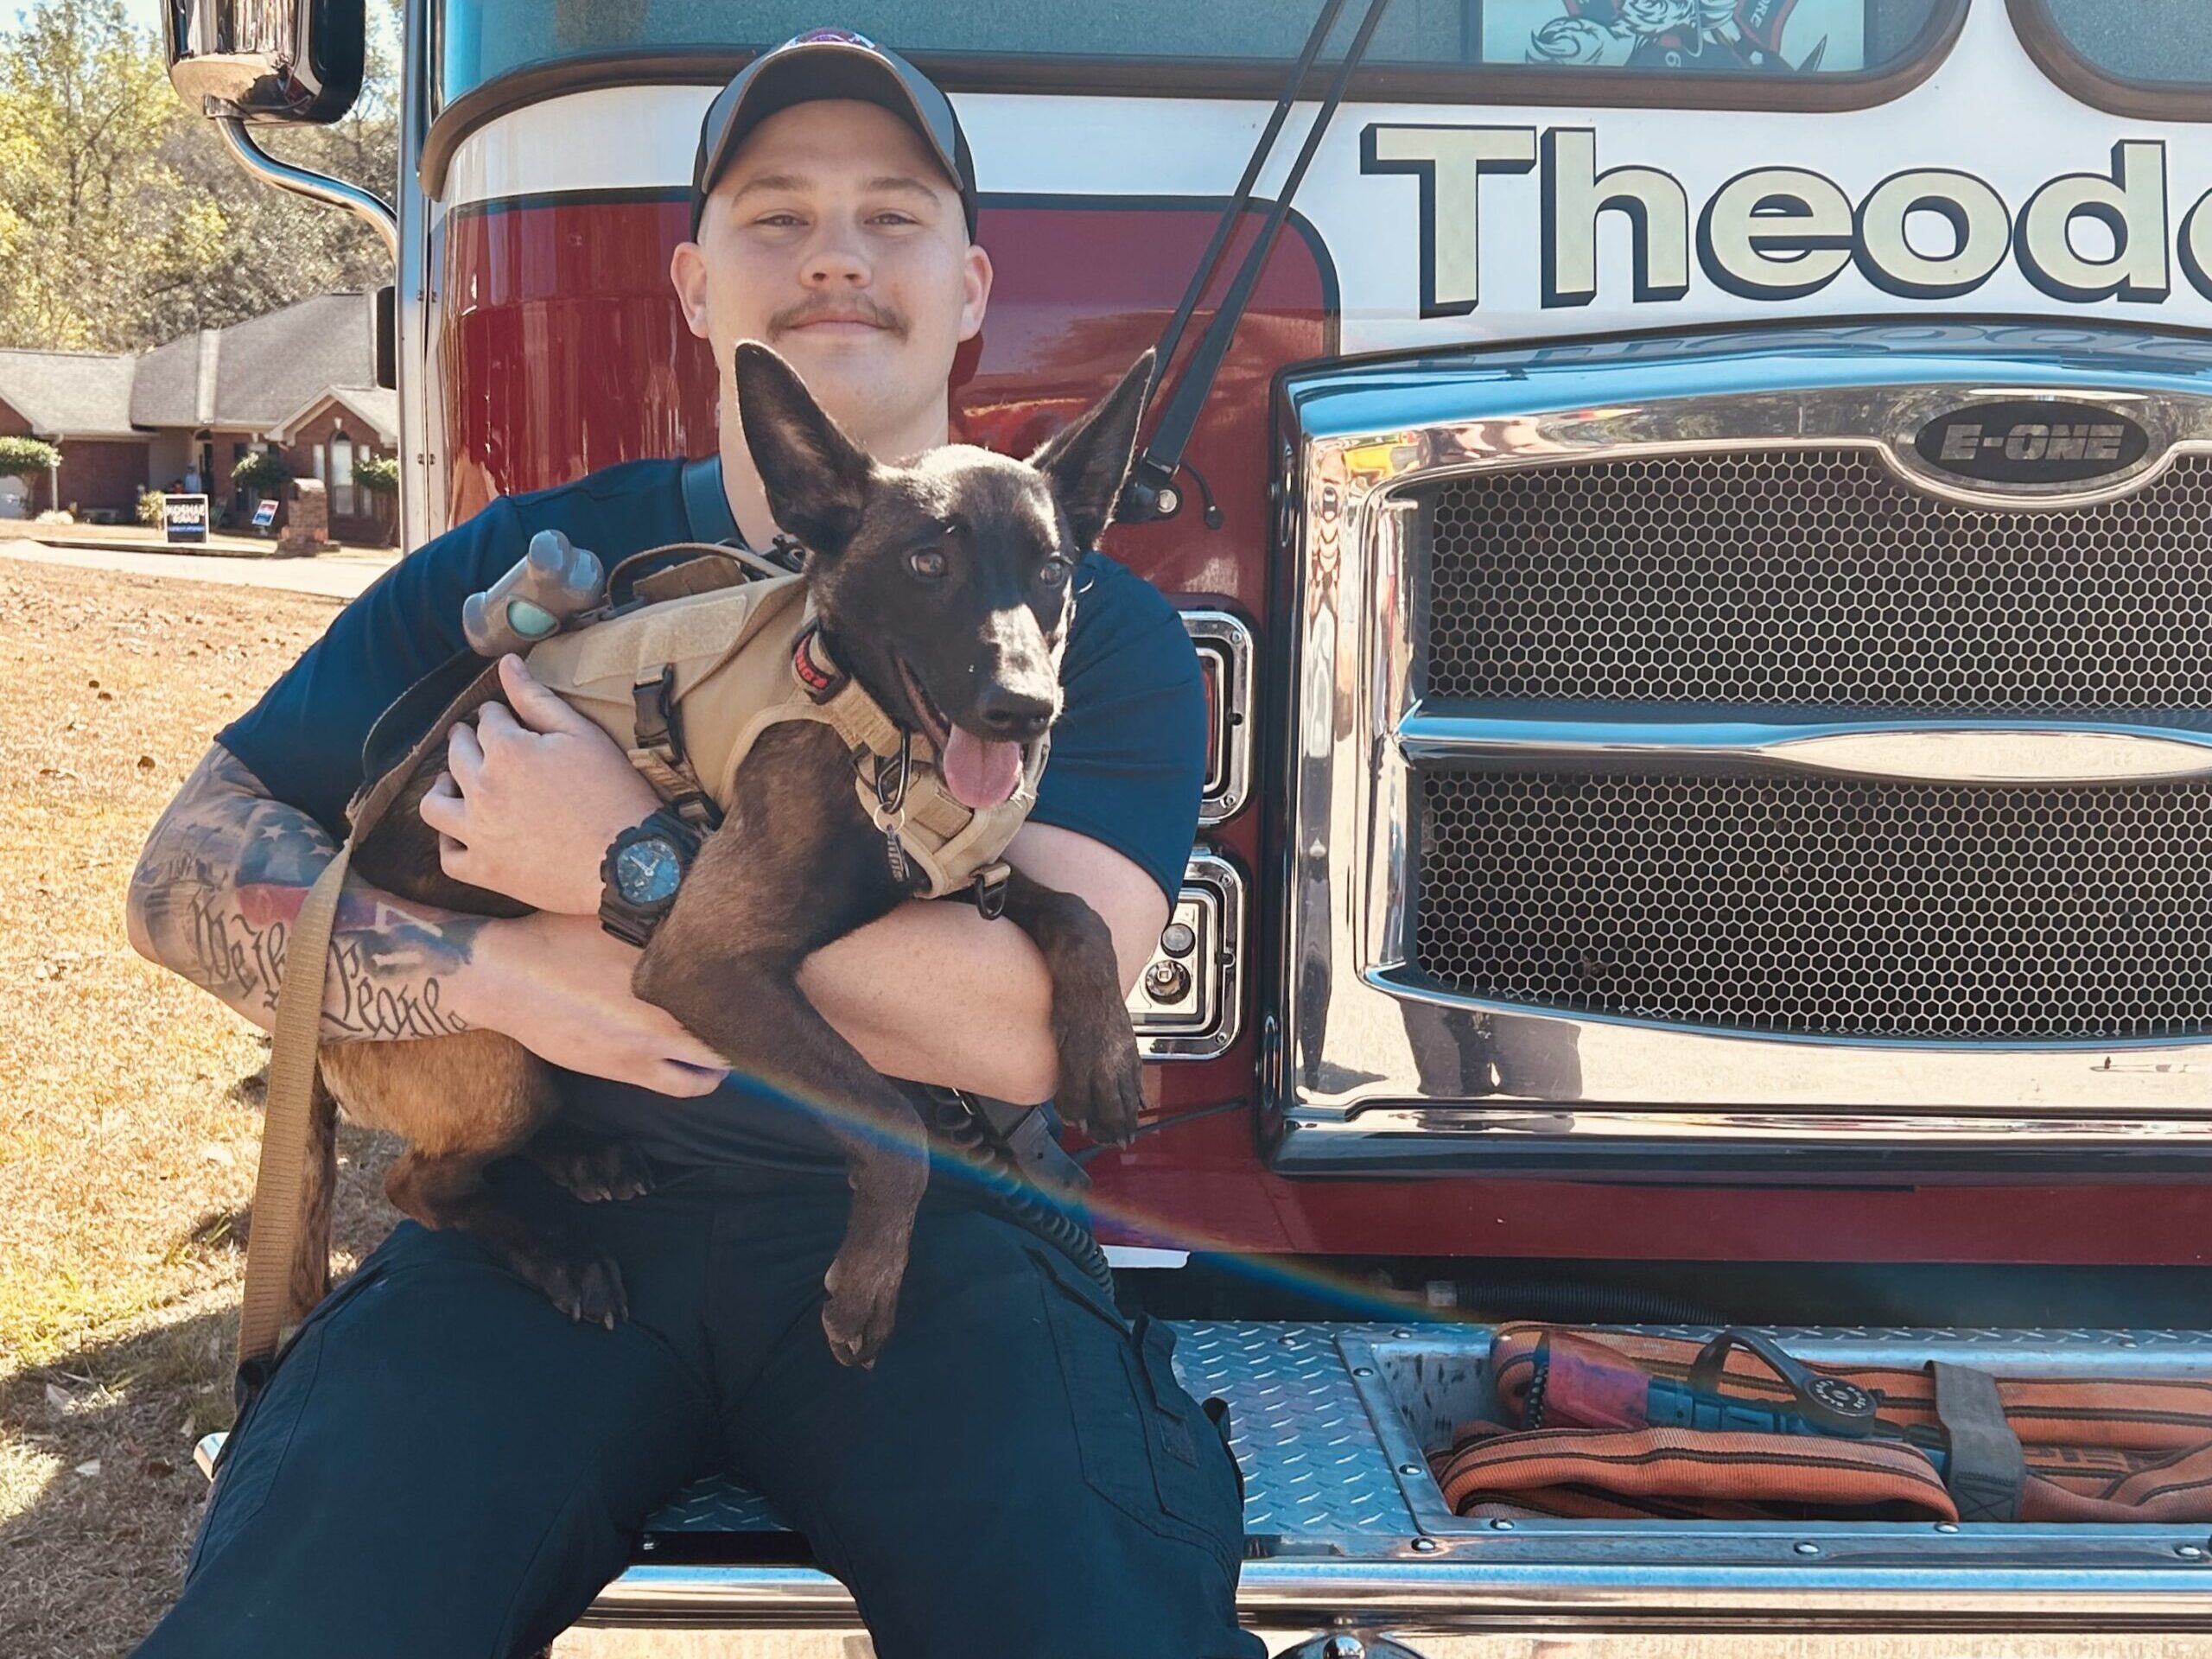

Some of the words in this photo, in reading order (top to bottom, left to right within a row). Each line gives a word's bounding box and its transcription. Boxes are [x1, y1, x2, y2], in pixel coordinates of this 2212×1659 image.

[1359, 122, 2212, 319] Theod
[1940, 423, 2126, 461] E-ONE
[187, 887, 258, 1000] We
